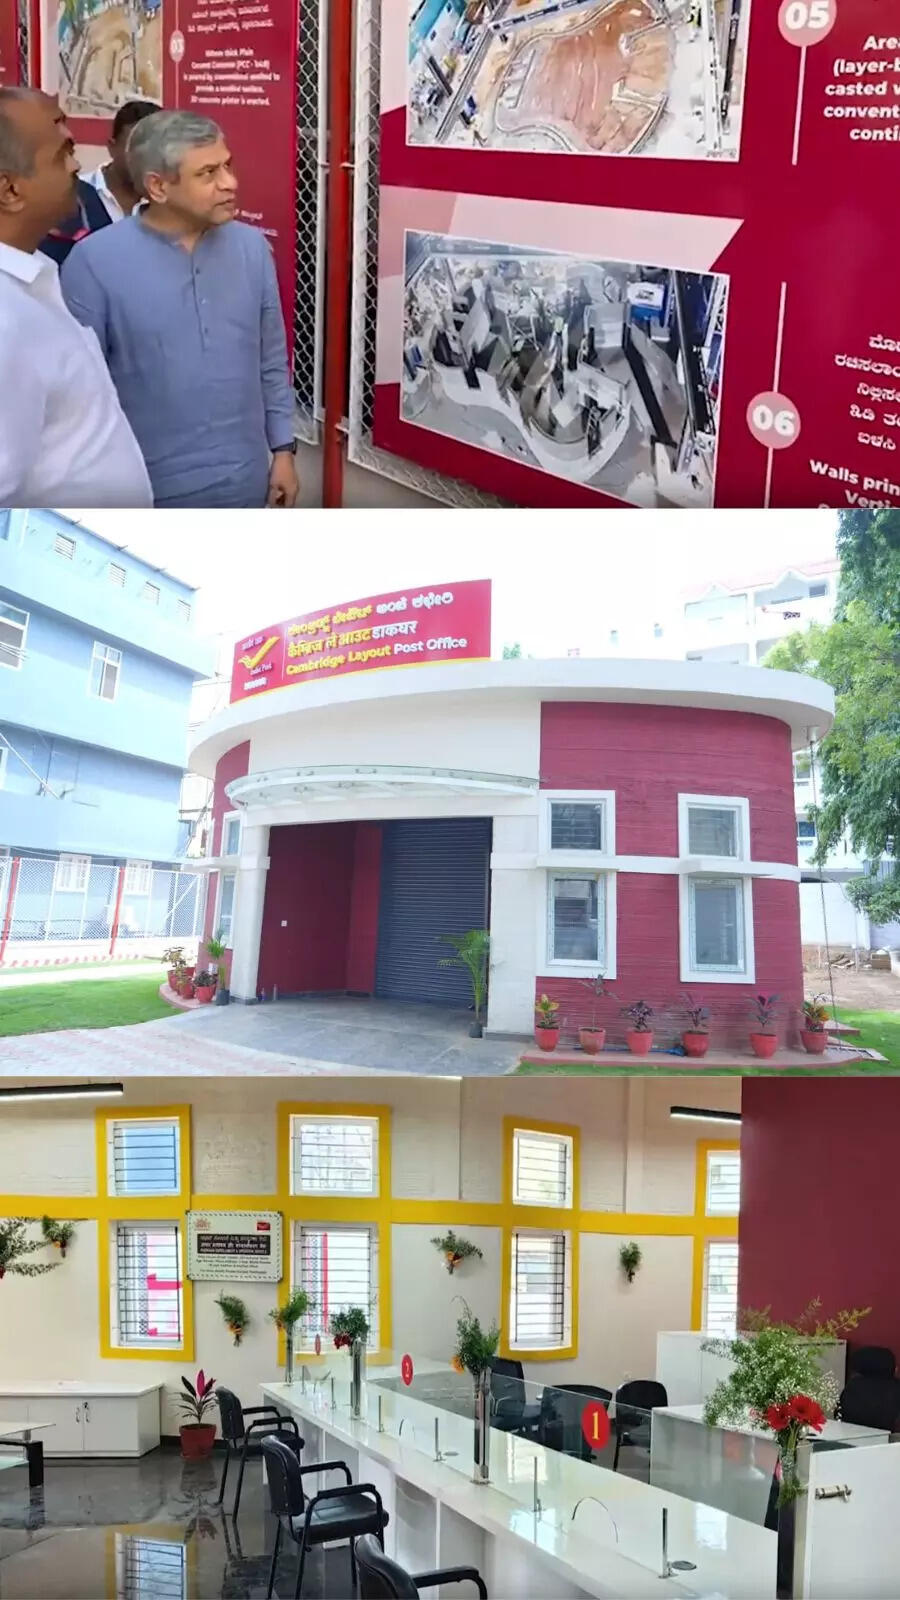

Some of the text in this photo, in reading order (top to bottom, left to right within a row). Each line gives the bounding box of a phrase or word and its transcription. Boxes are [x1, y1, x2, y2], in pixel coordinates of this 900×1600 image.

[785, 0, 830, 30] 05
[863, 35, 900, 51] Are
[824, 81, 888, 96] casted
[752, 404, 795, 437] 06
[809, 459, 859, 485] Walls
[372, 620, 418, 639] डाकघर
[286, 636, 468, 675] Cambridge Layout Post Office
[592, 1411, 600, 1441] 1
